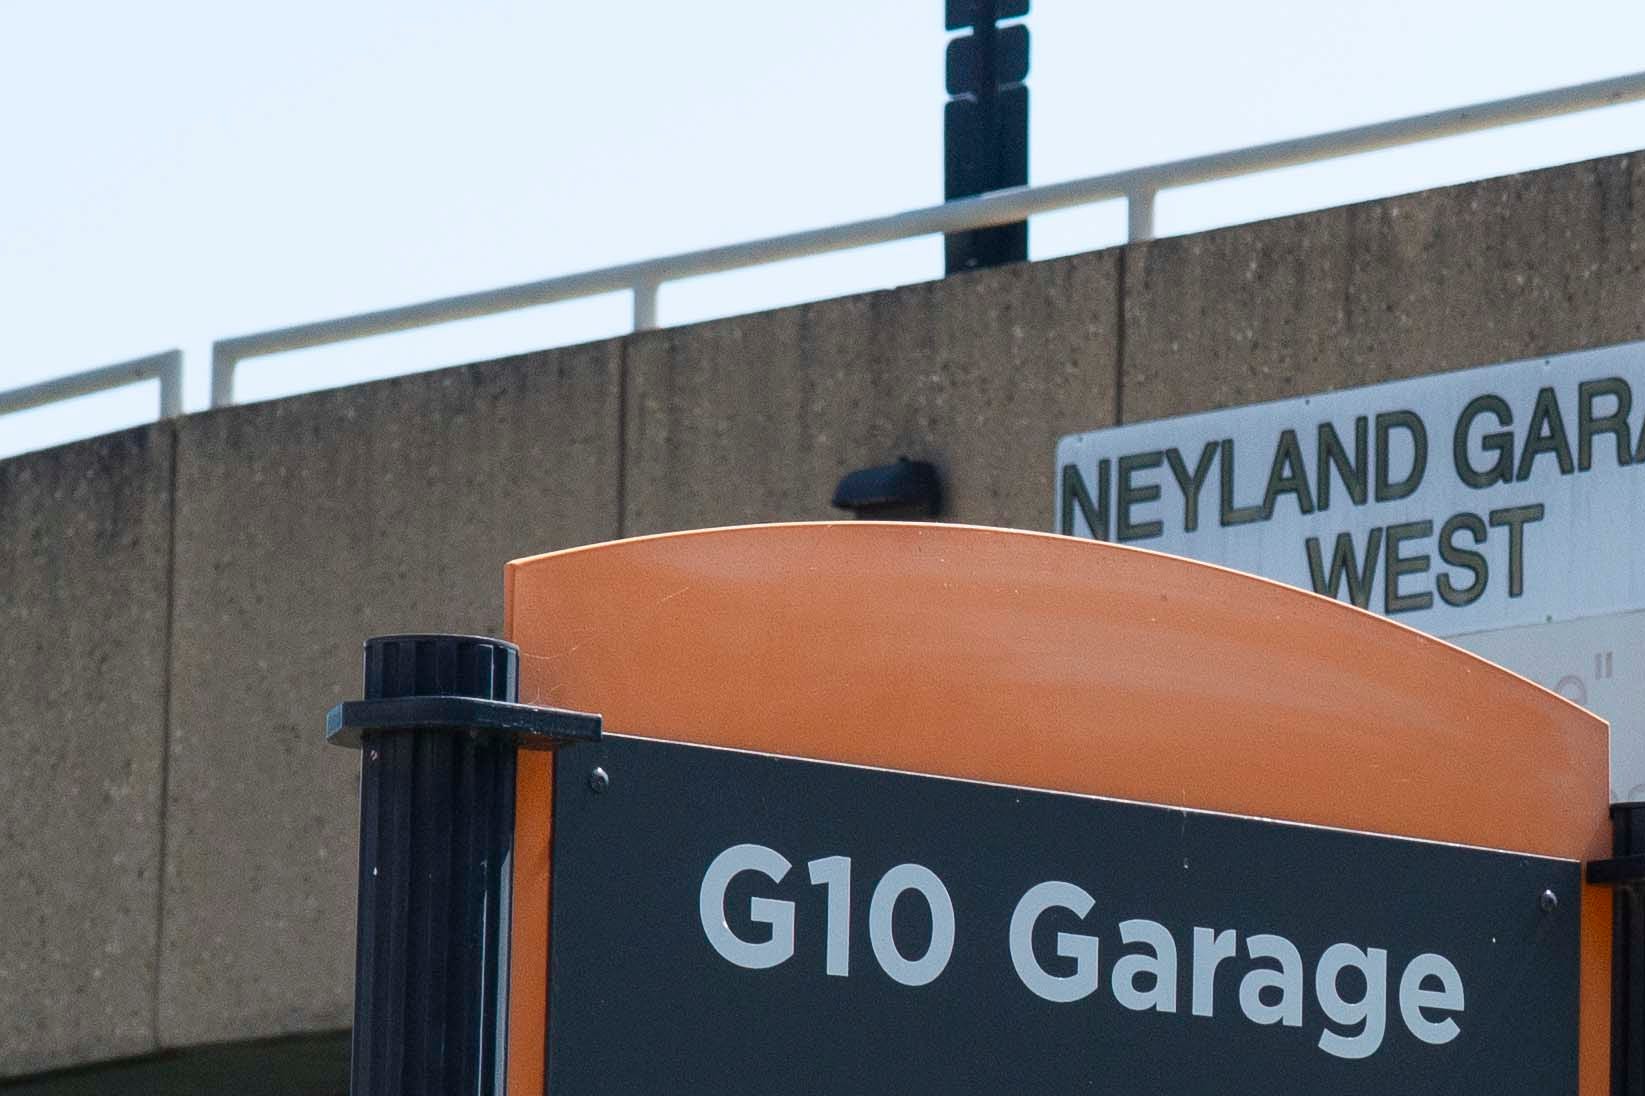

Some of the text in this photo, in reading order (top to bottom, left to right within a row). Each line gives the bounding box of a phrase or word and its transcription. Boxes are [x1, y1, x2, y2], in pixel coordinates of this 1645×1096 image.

[1062, 408, 1428, 541] NEYLAND
[1305, 503, 1544, 613] WEST
[700, 843, 1464, 1059] G10 Garage
